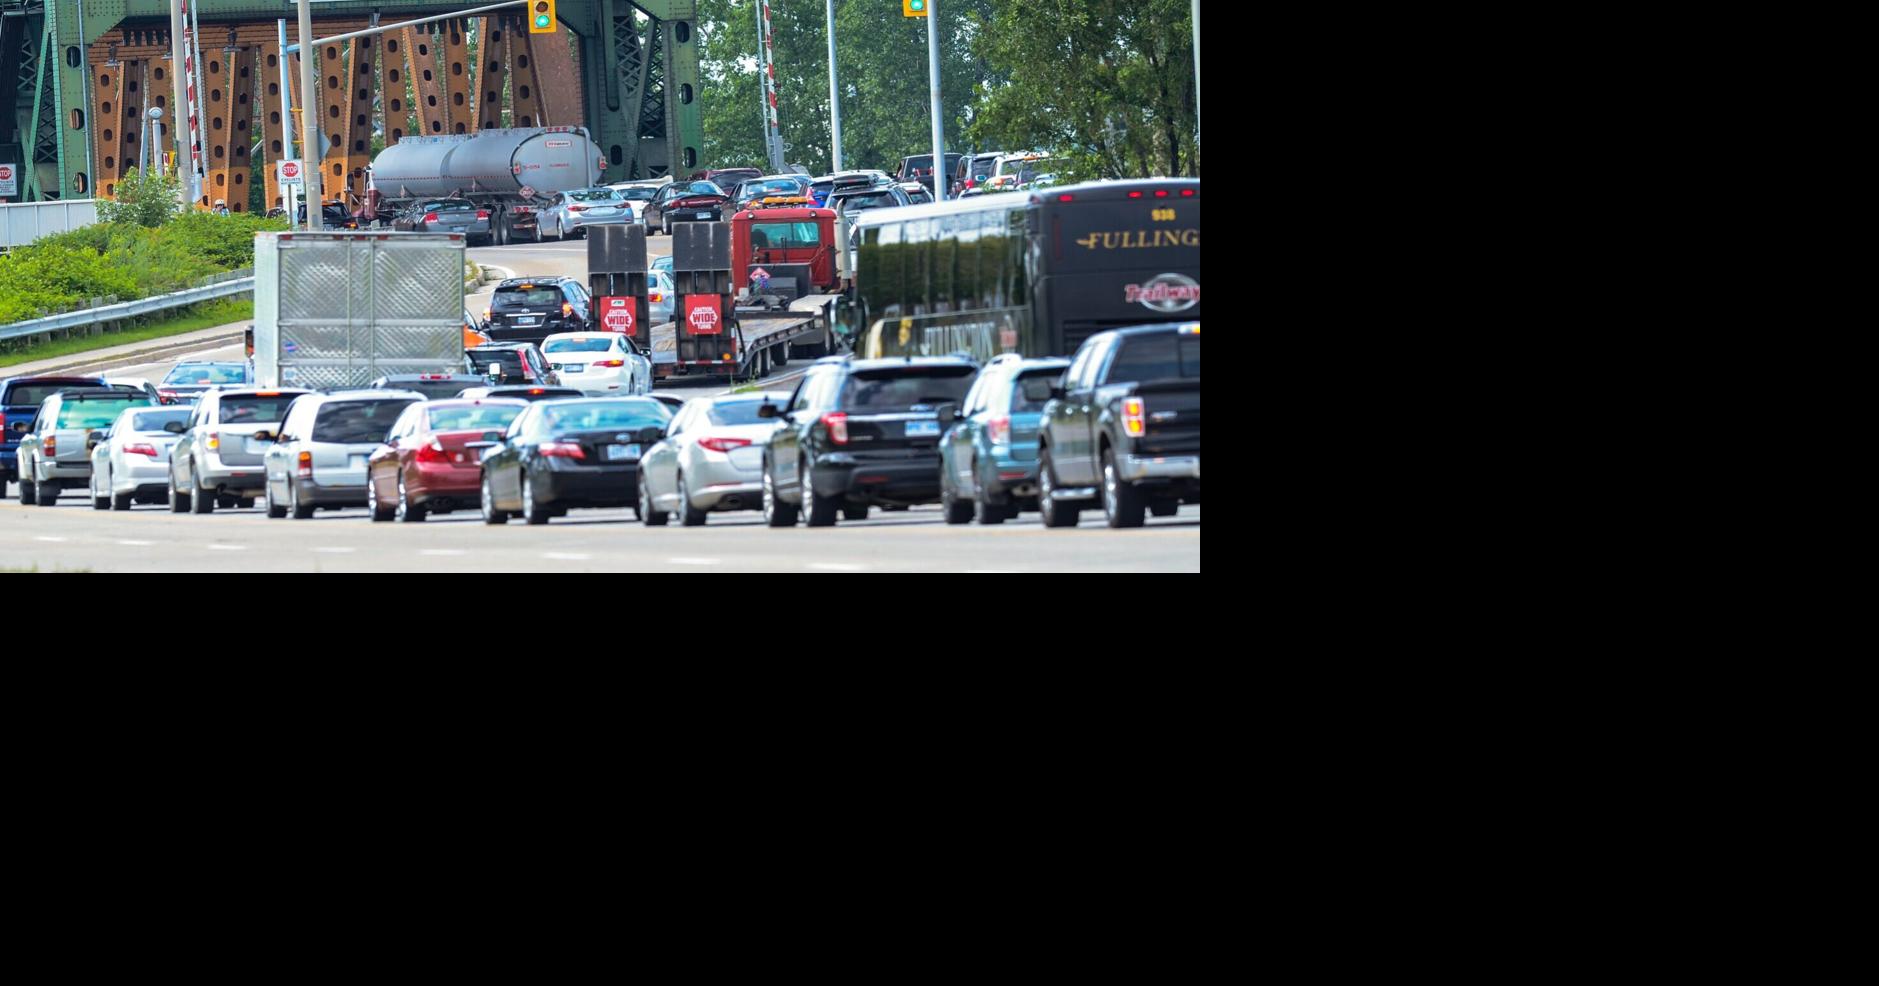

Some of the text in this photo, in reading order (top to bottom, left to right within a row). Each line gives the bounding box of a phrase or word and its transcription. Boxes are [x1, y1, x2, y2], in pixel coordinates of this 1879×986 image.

[283, 166, 298, 174] STOP
[607, 316, 630, 325] WIDE
[691, 313, 715, 323] WIDE
